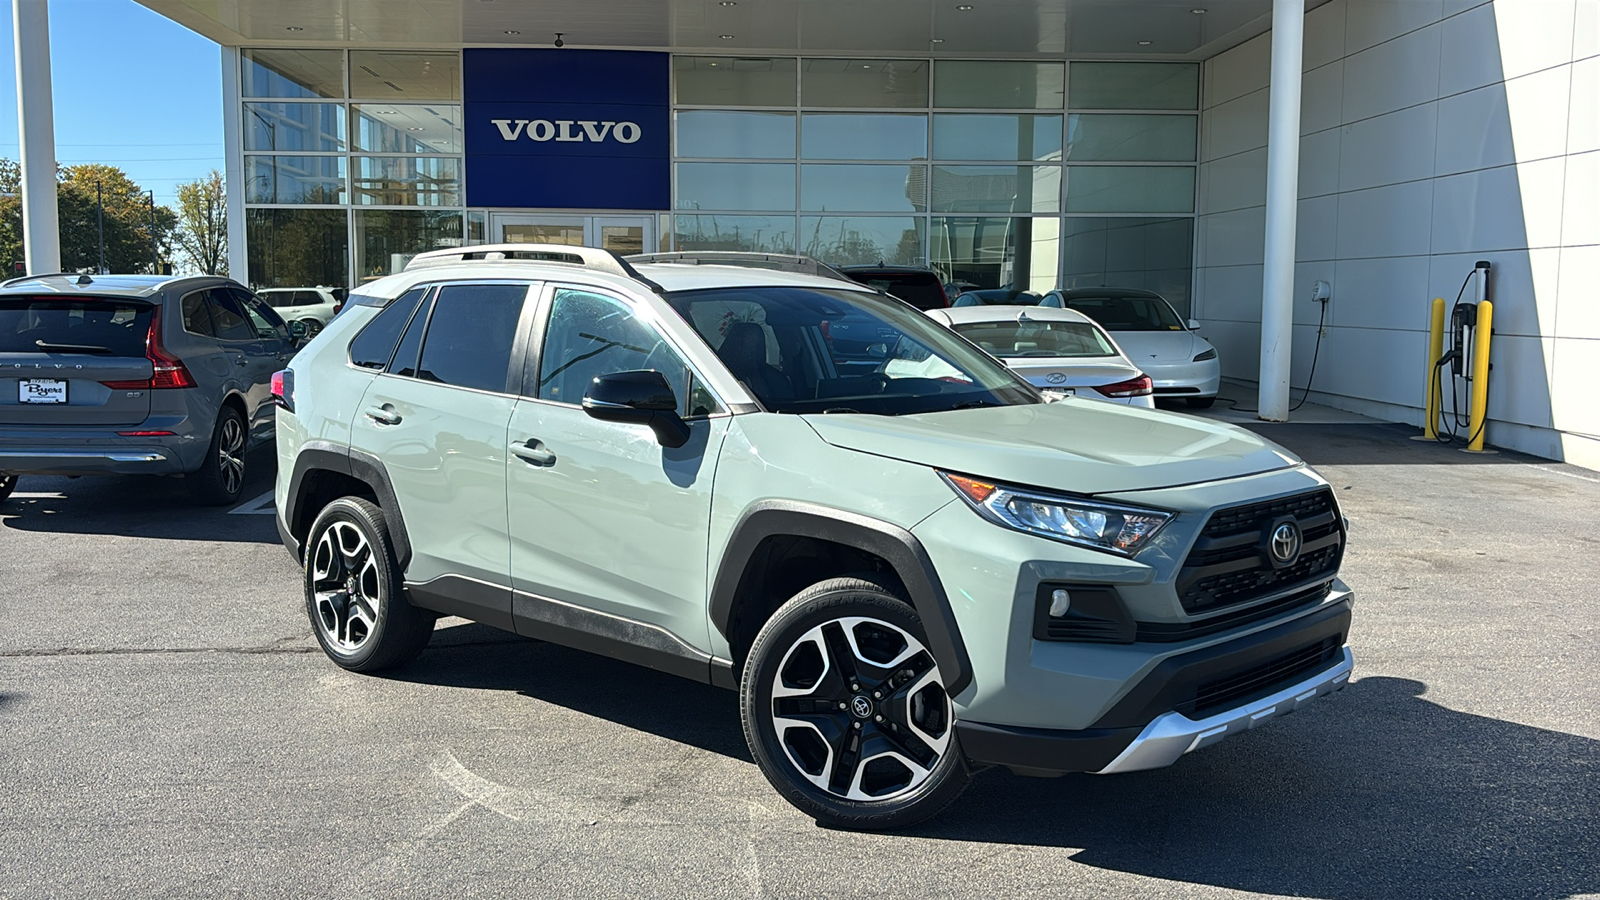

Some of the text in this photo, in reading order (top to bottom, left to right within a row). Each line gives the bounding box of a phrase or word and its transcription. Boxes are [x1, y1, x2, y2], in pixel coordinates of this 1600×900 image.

[491, 119, 642, 143] VOLVO
[23, 384, 62, 397] Byers
[806, 595, 855, 614] OPEN
